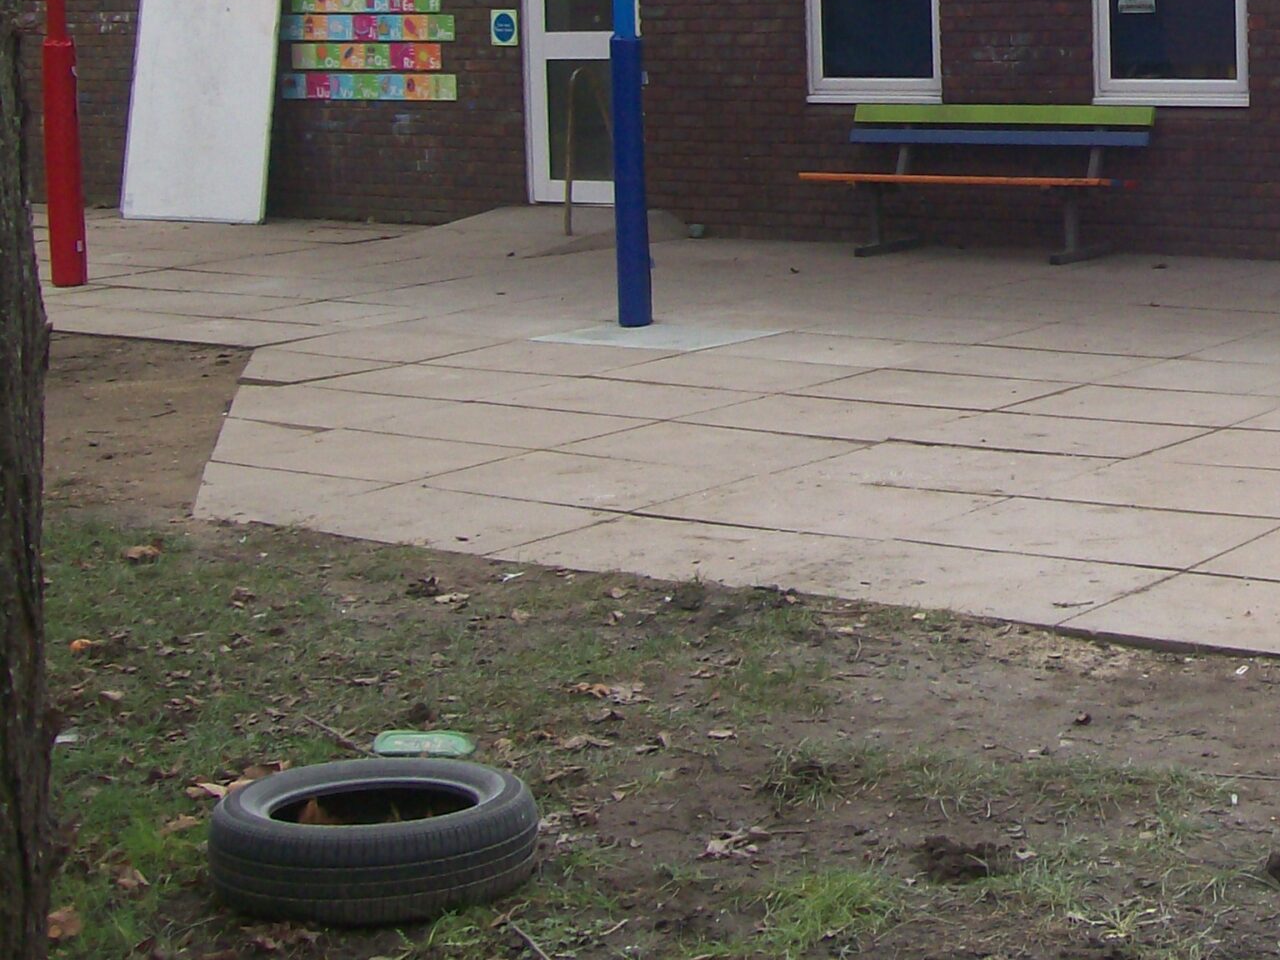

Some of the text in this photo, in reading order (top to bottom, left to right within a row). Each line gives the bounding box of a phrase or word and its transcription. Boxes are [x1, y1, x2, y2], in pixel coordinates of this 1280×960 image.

[374, 0, 389, 9] Dd
[402, 0, 414, 10] Ee
[429, 0, 440, 9] Ff
[324, 57, 339, 67] Oo
[403, 57, 414, 67] Rr
[429, 57, 441, 67] Ss
[316, 87, 330, 98] Uu
[340, 88, 353, 98] Vv
